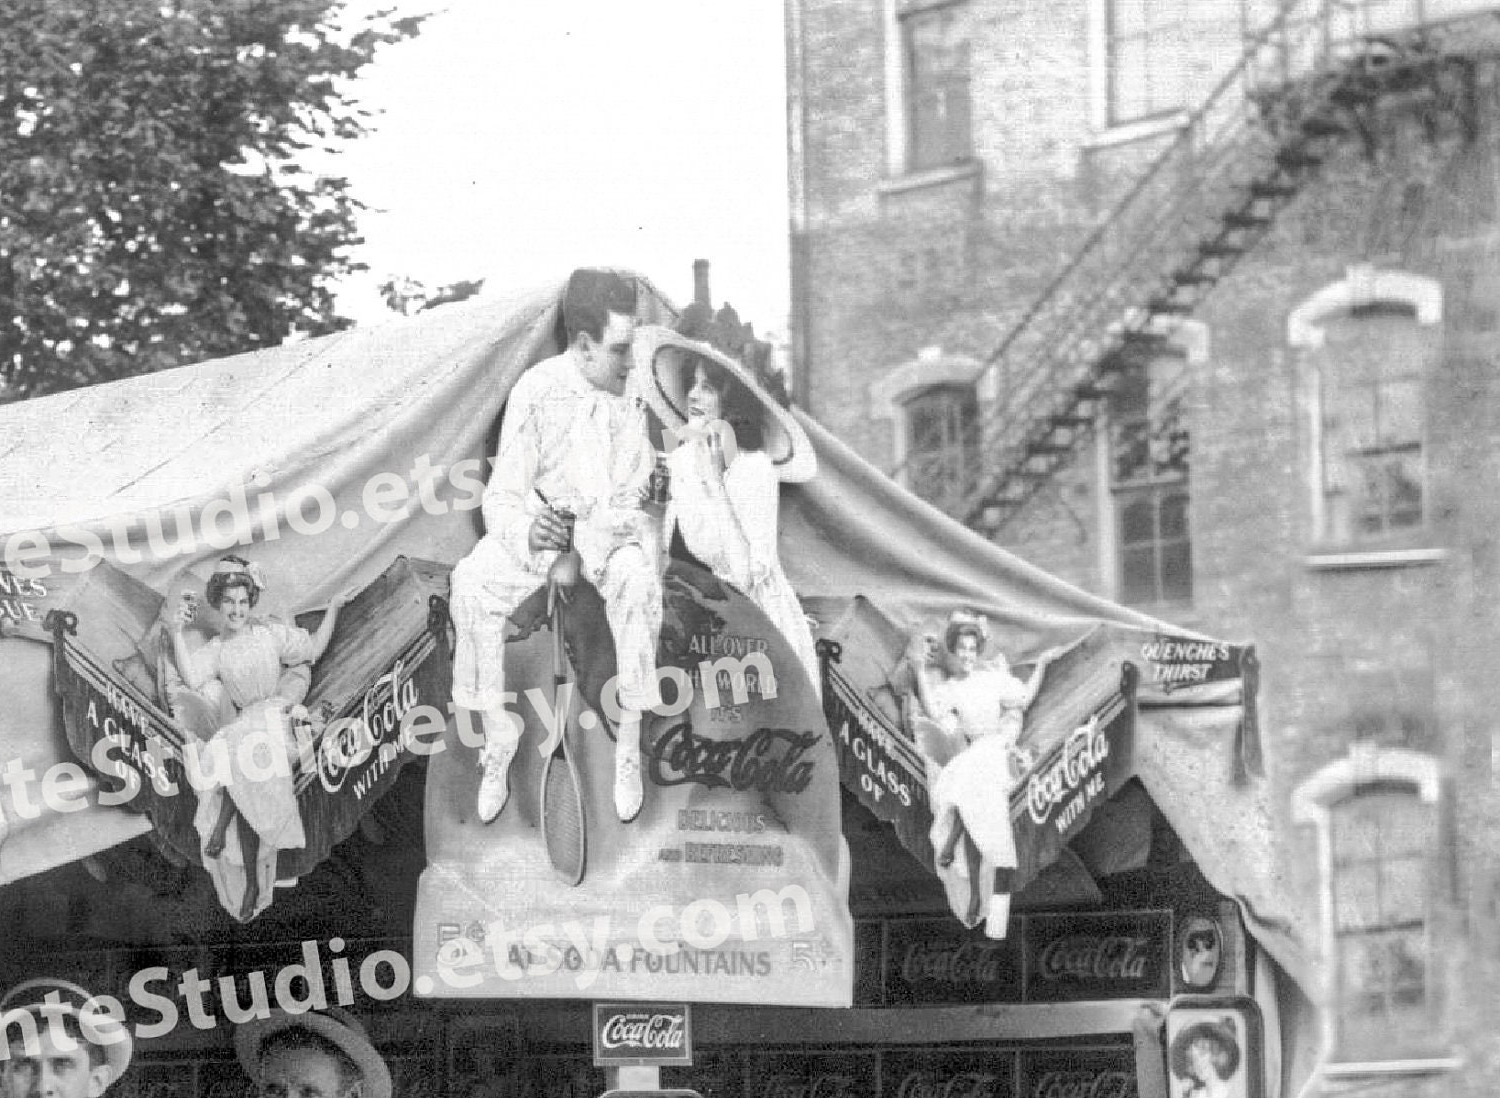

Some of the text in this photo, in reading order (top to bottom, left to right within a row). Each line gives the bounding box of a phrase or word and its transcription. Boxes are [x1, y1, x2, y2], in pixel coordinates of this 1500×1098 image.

[1140, 641, 1230, 661] QUENCHES
[1153, 662, 1214, 682] THIRST
[86, 699, 171, 792] A GLASS
[839, 719, 912, 807] A GLASS
[861, 773, 884, 802] OF
[631, 946, 772, 977] FOUNTAINS
